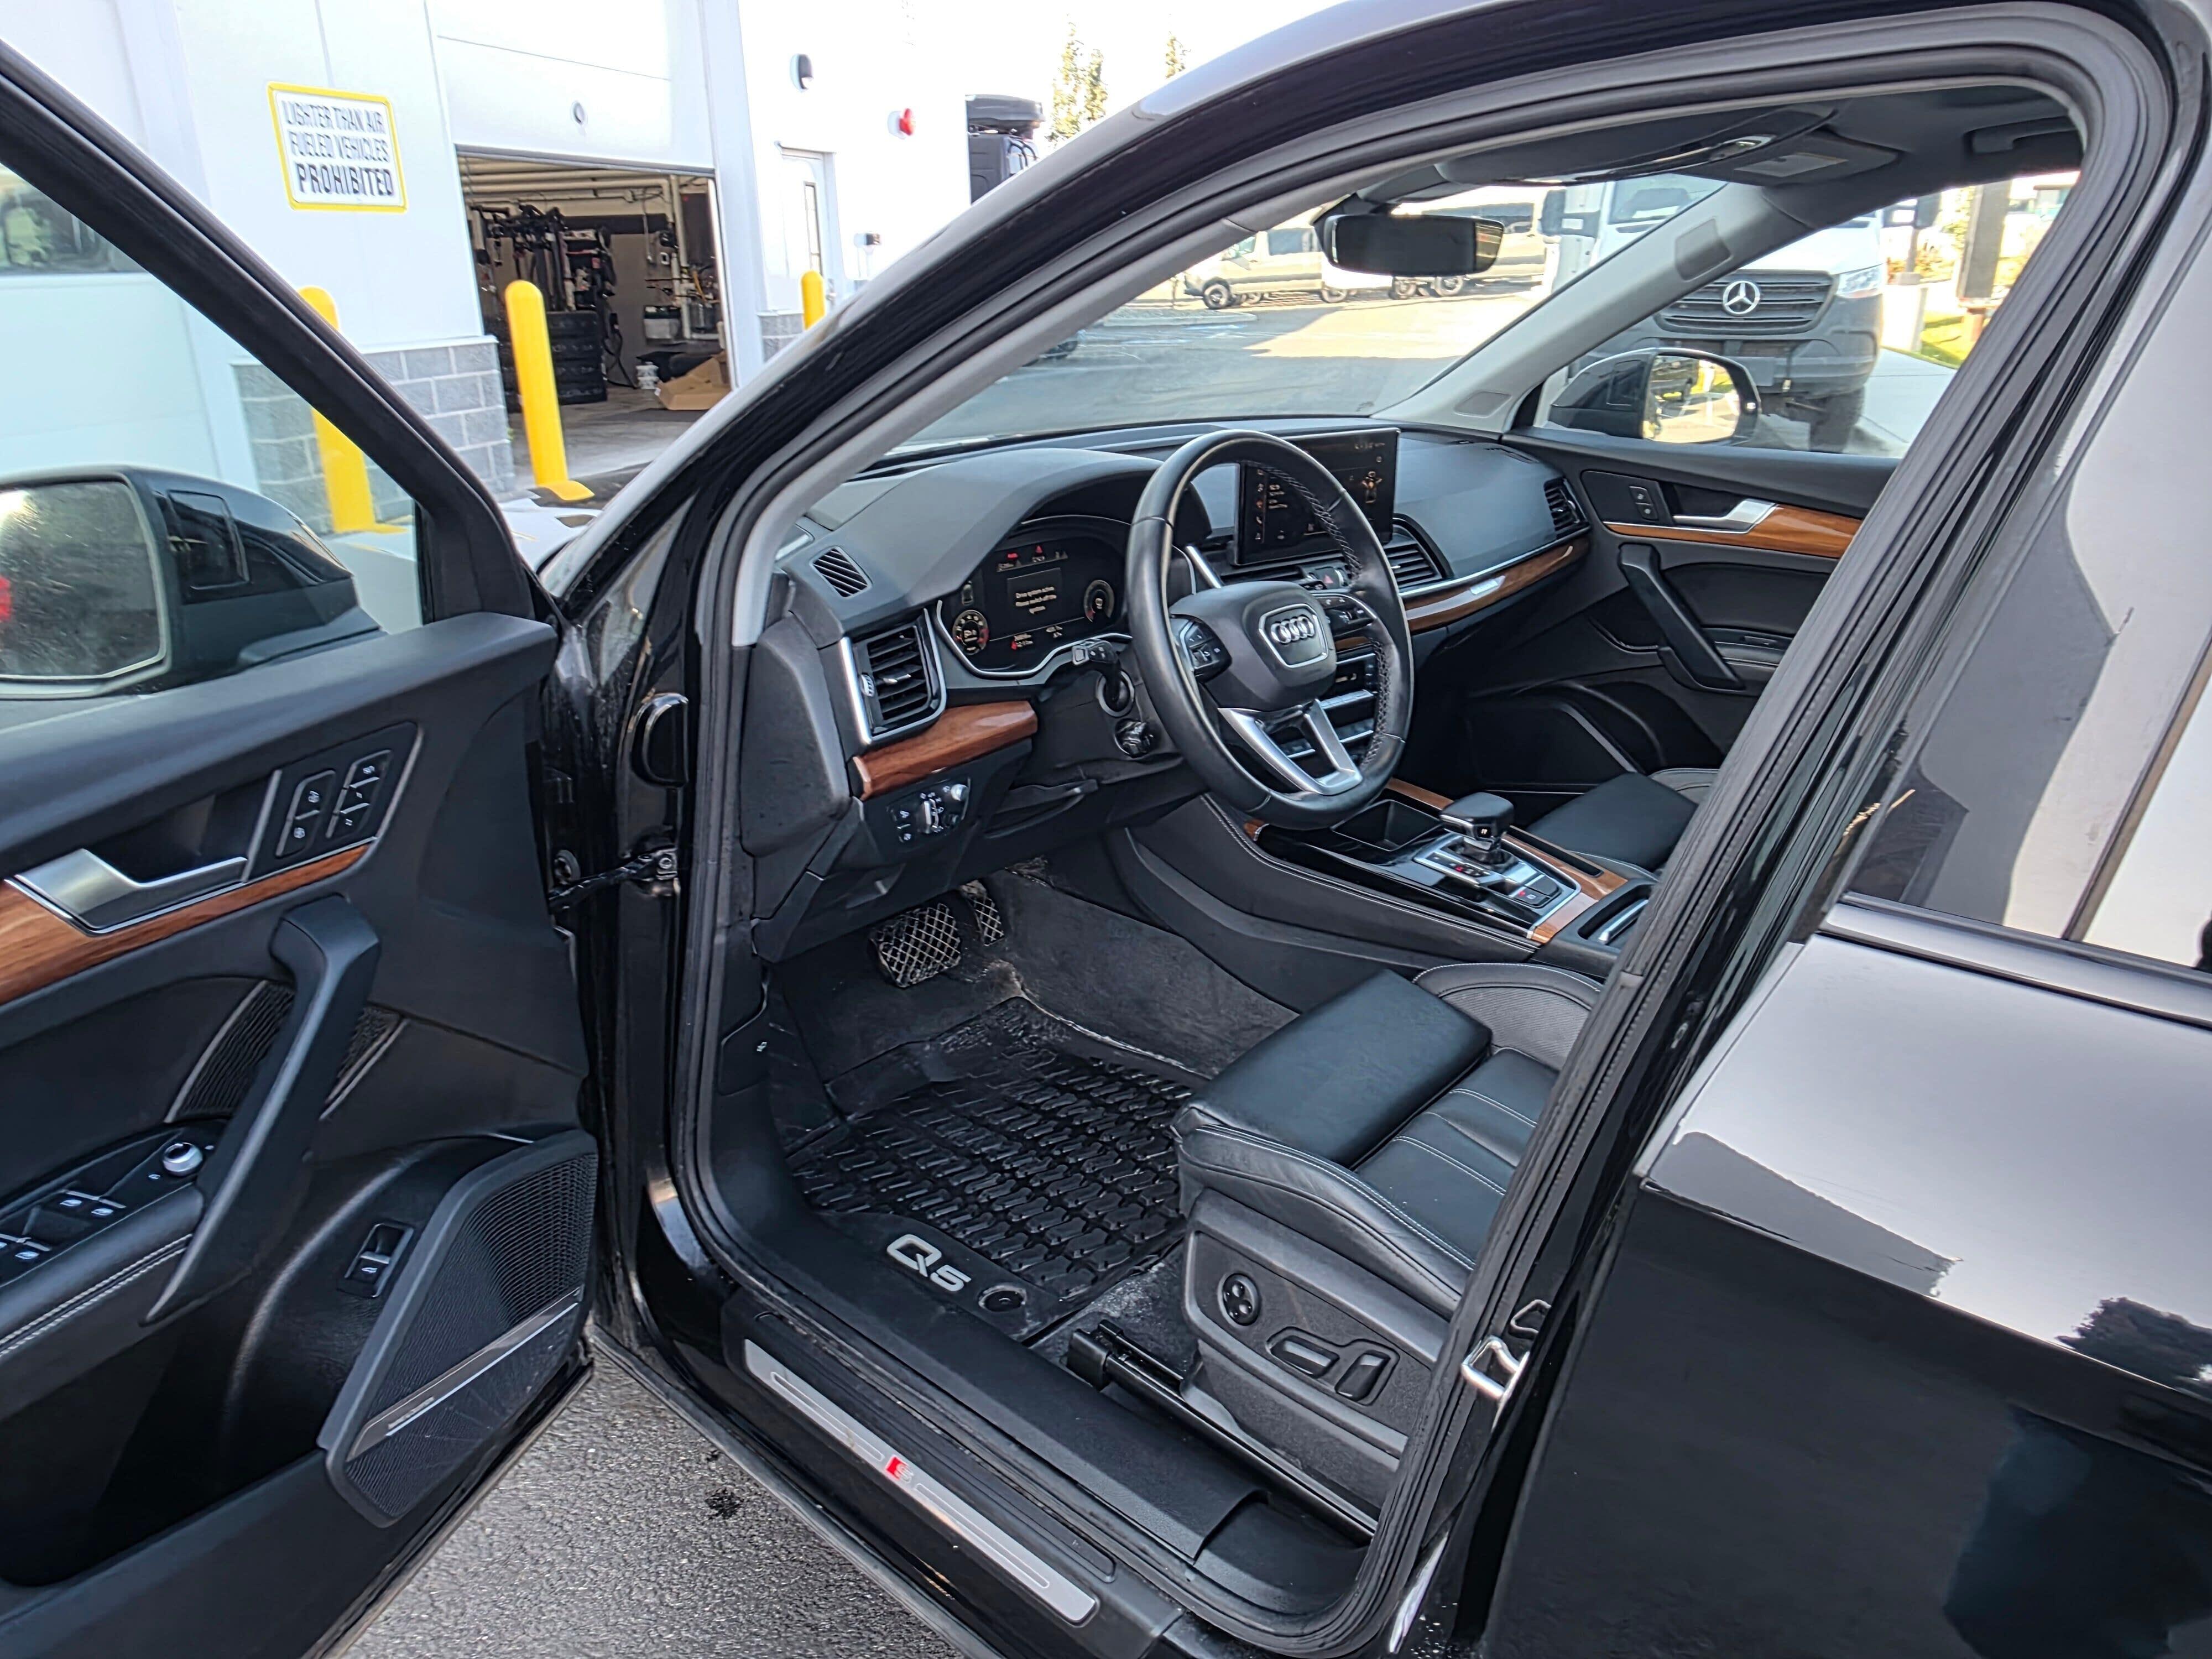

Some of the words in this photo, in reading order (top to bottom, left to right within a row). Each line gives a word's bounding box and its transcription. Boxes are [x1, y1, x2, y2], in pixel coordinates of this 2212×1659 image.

[331, 106, 366, 133] THAN
[295, 163, 394, 196] PROHIBITED
[886, 1234, 972, 1292] Q5
